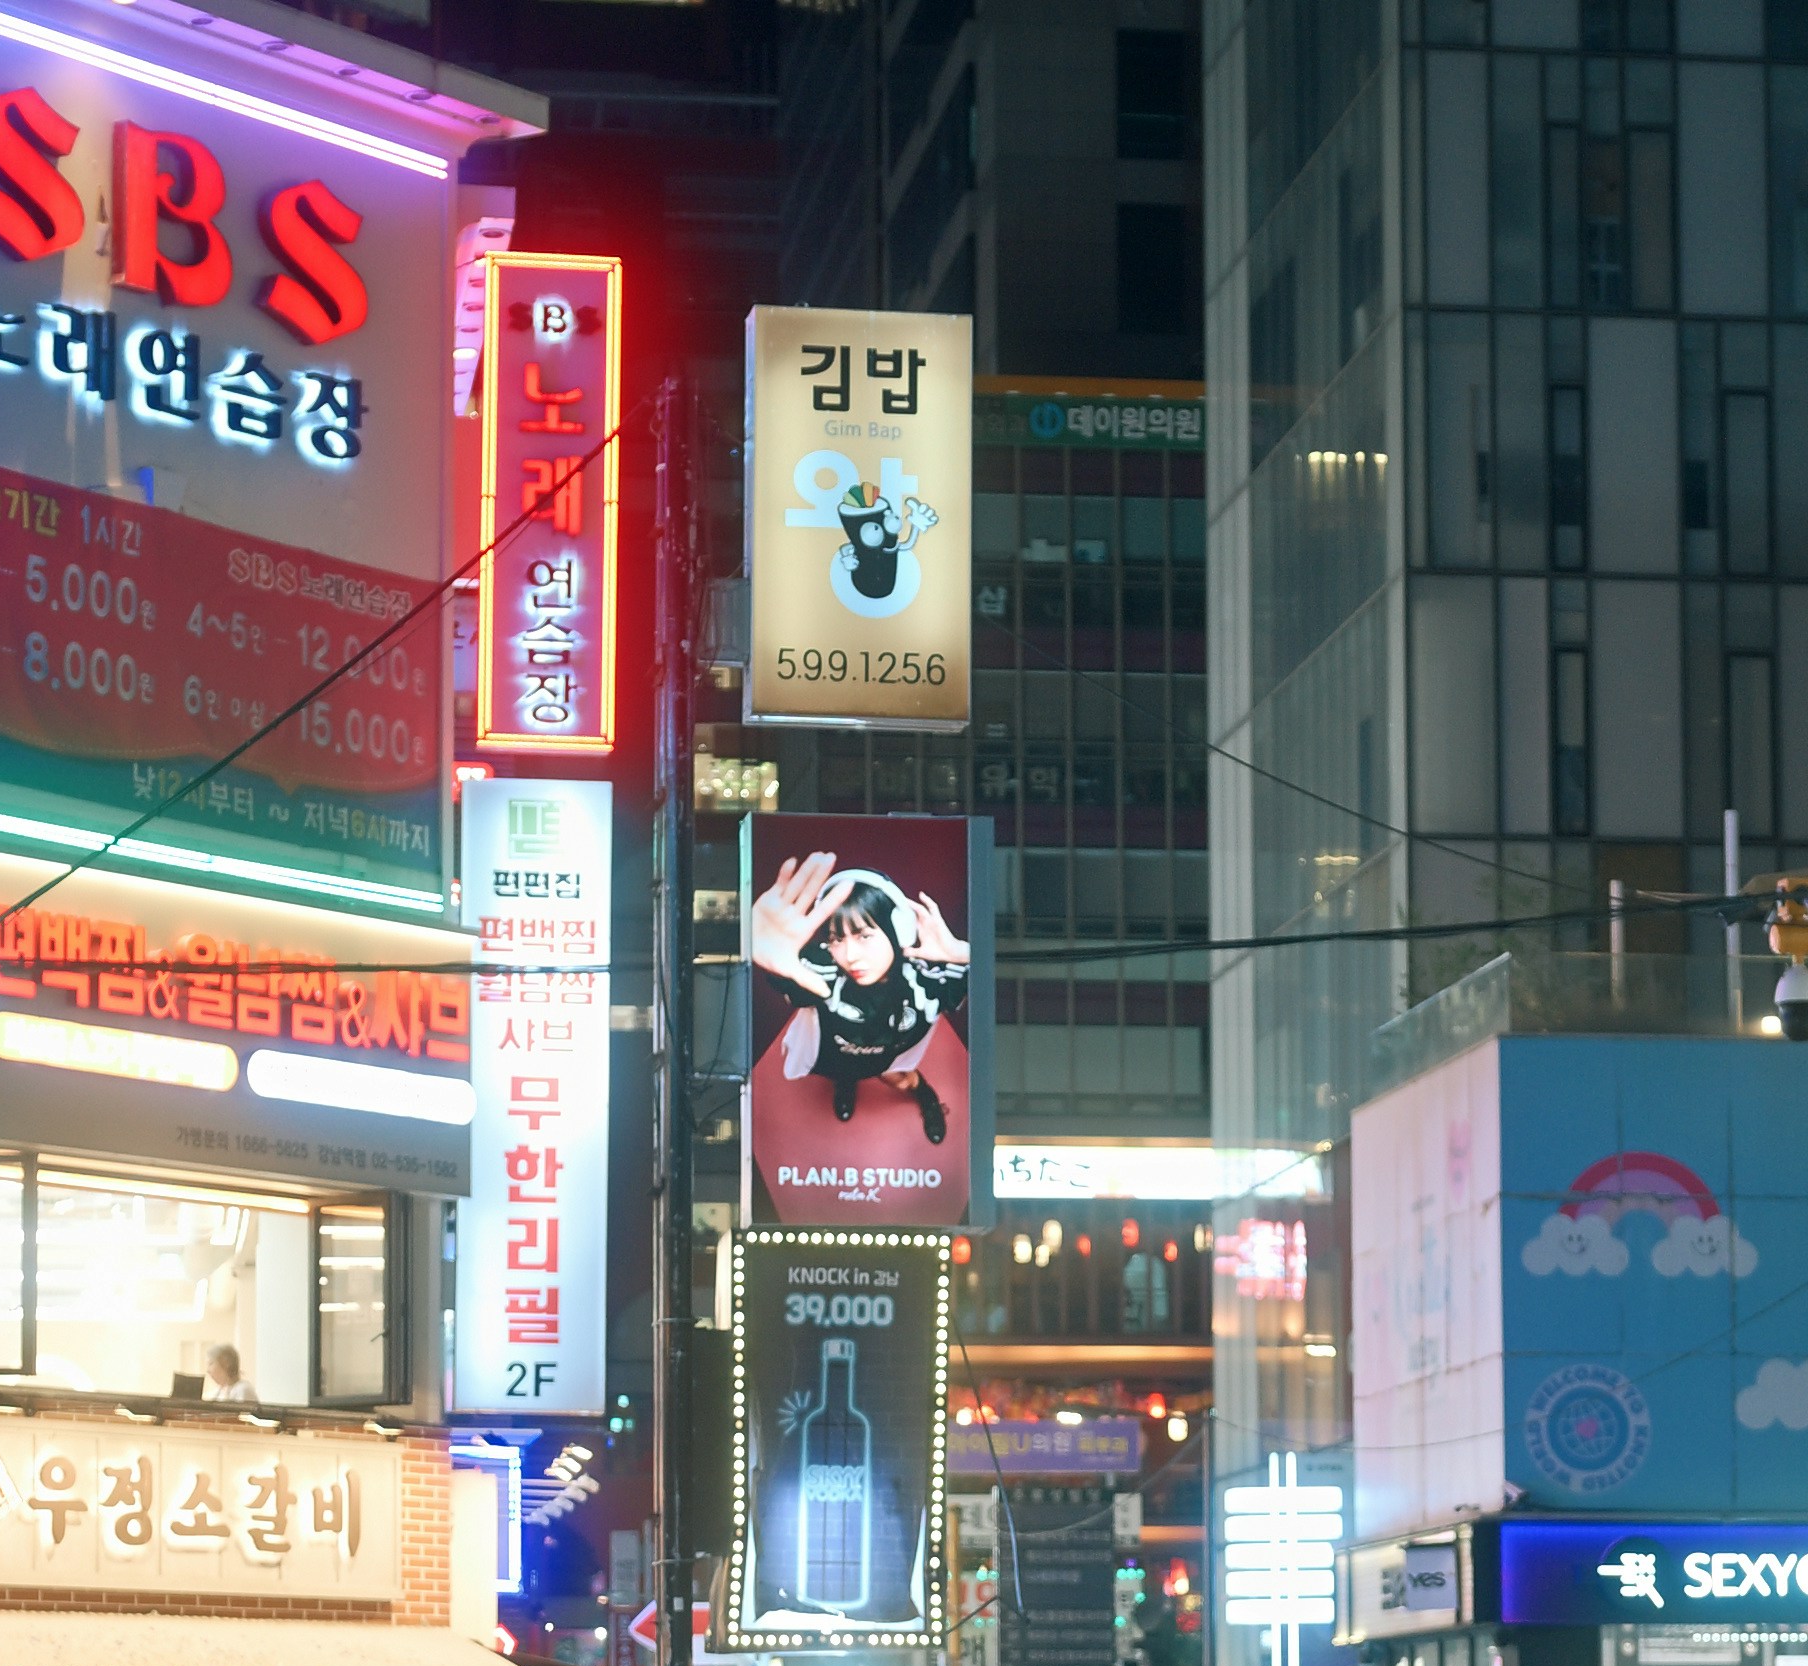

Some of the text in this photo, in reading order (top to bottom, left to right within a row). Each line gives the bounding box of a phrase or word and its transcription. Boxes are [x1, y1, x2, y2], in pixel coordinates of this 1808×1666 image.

[800, 345, 926, 415] 김밥
[824, 420, 902, 441] Gim Bap
[498, 1018, 575, 1053] 샤브
[777, 1166, 942, 1188] PLAN.B STUDIO
[504, 1075, 563, 1346] 무한리필
[788, 1267, 850, 1285] KNOCK
[853, 1268, 870, 1285] in
[506, 1362, 559, 1397] 2F
[27, 1454, 361, 1560] 우정소갈비
[1407, 1569, 1446, 1592] yes
